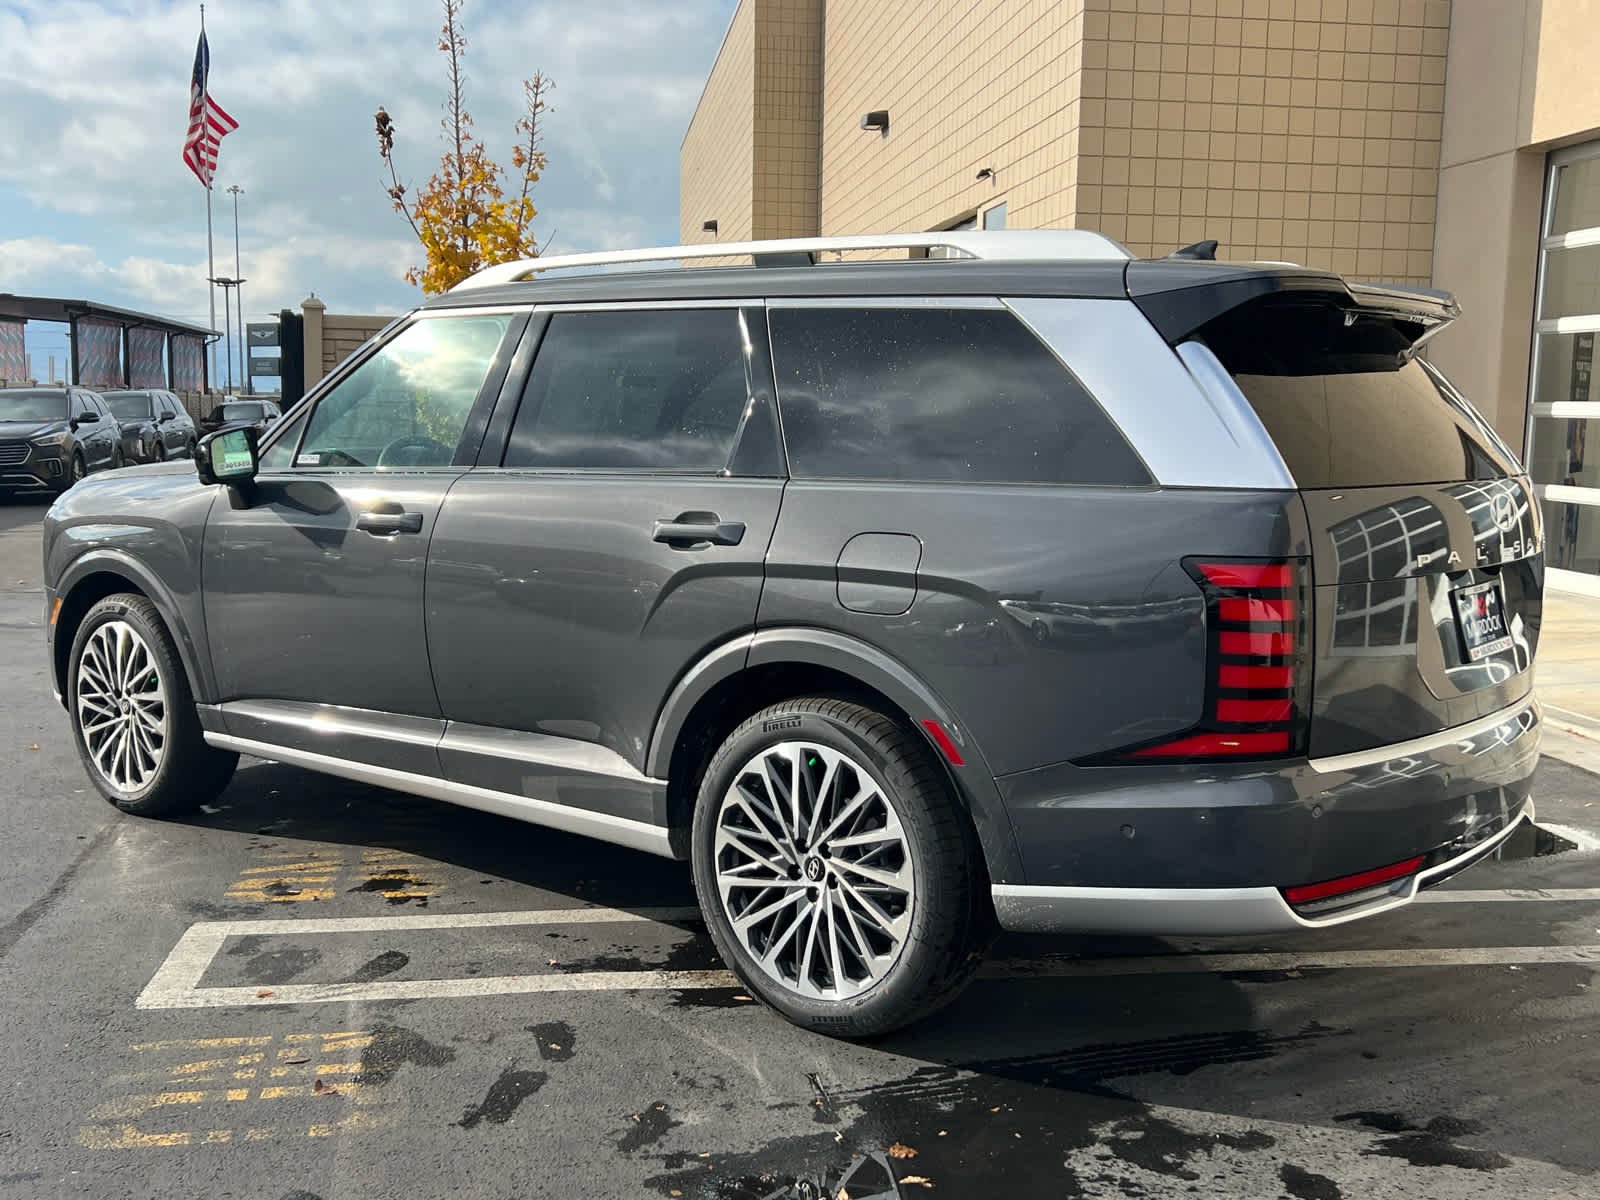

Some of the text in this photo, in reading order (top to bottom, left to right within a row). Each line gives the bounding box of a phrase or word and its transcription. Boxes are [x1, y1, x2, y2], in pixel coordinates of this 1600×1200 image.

[1417, 533, 1545, 567] PALSA
[1466, 615, 1502, 639] MRDOCK
[762, 715, 801, 733] PIRELLI
